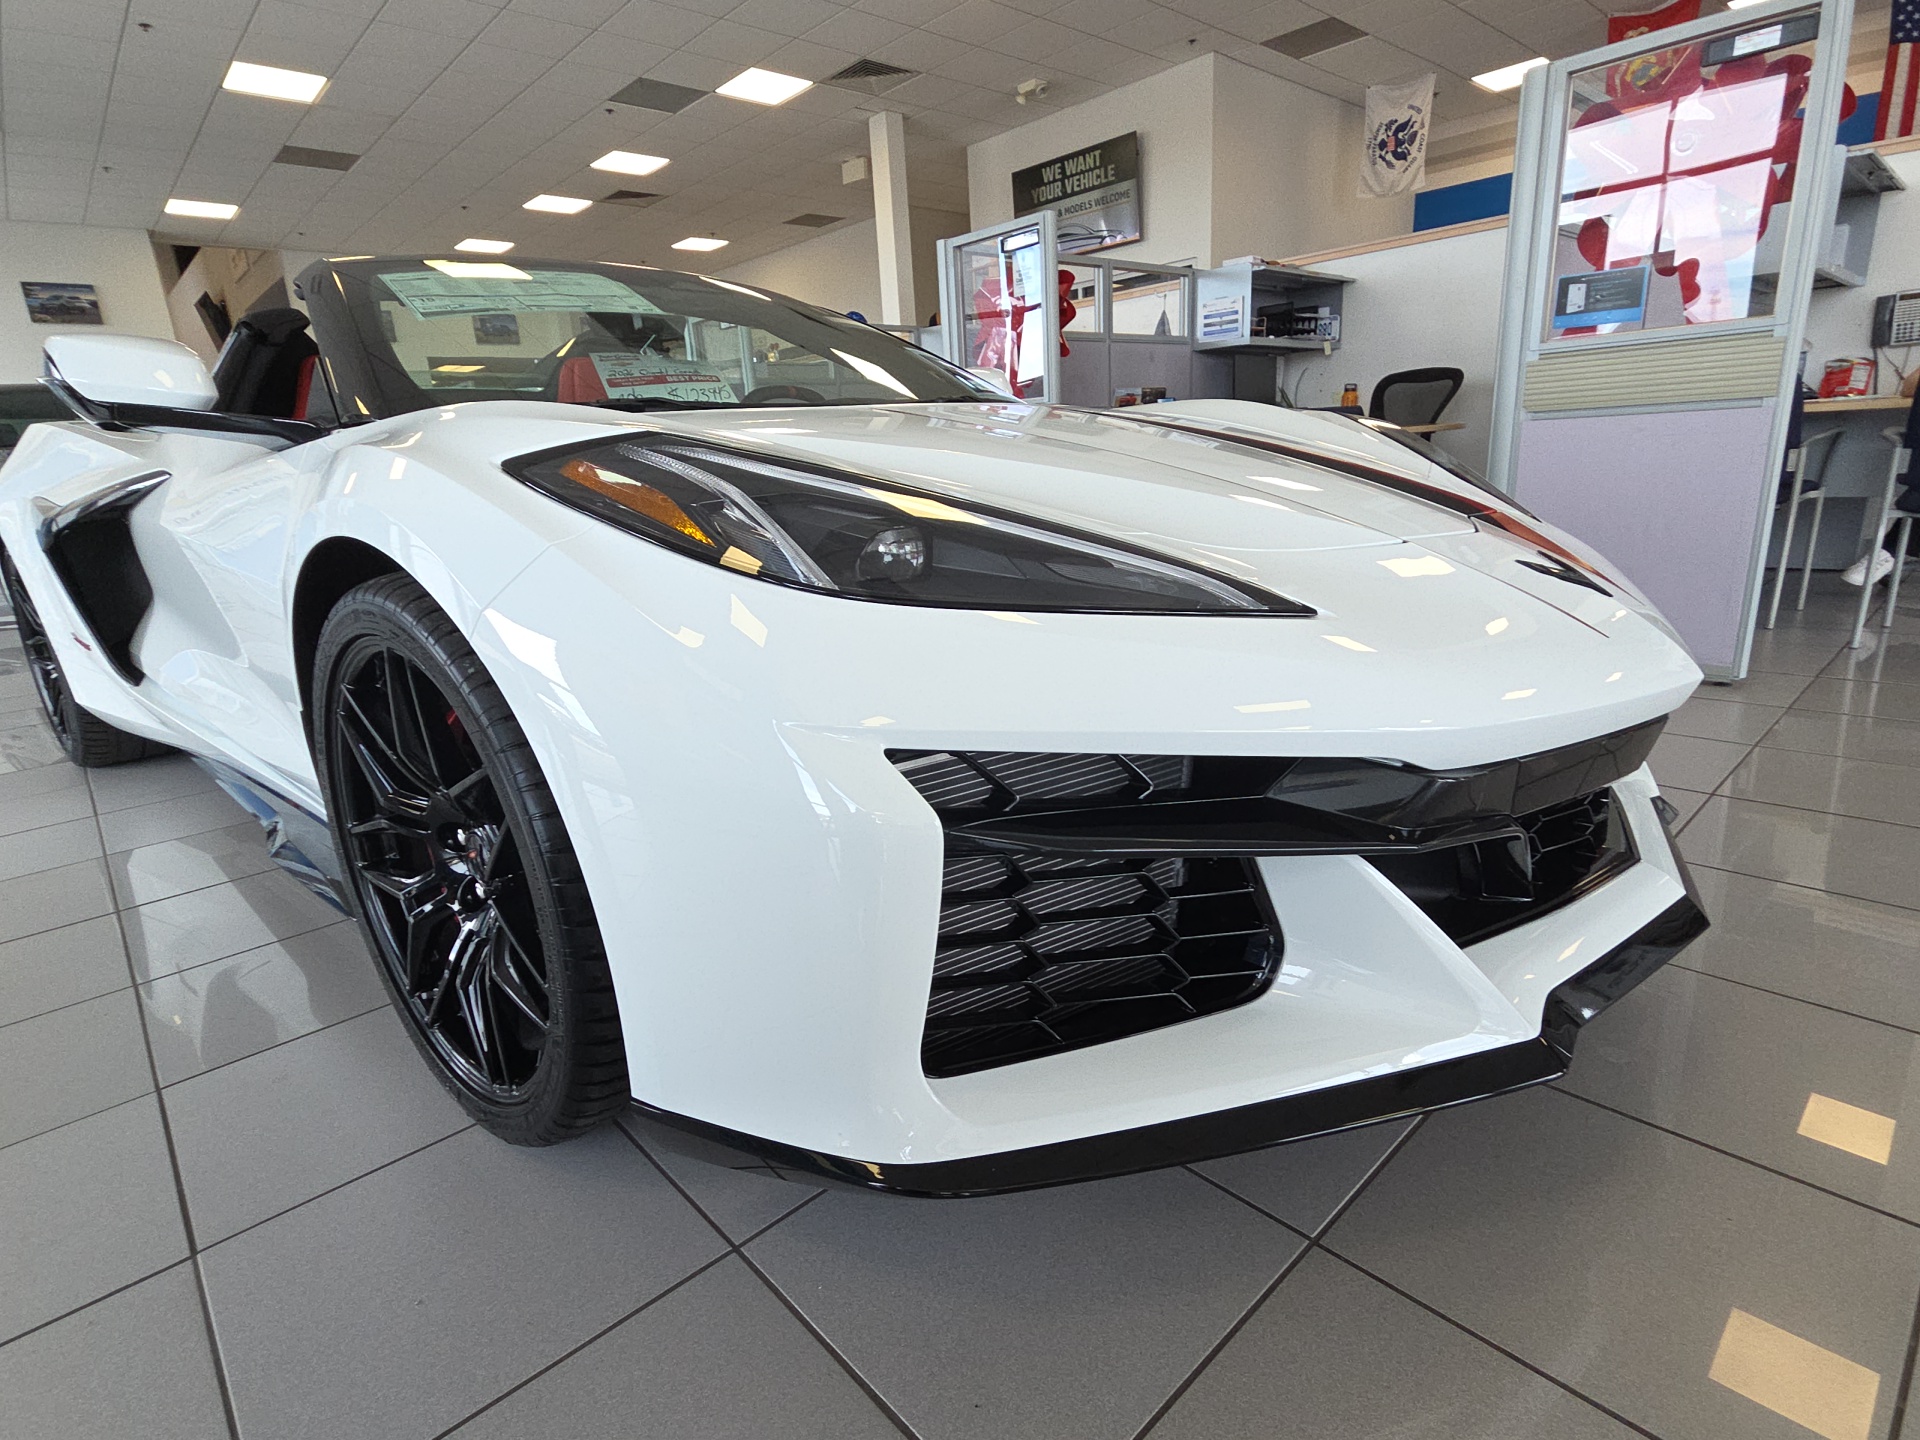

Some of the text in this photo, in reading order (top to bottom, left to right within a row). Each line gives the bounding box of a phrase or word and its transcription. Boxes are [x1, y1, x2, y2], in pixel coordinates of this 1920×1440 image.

[1042, 150, 1102, 183] WE WANT
[1031, 164, 1115, 203] YOUR VEHICLE
[1064, 201, 1093, 216] MODELS
[1094, 189, 1131, 208] WELCOME
